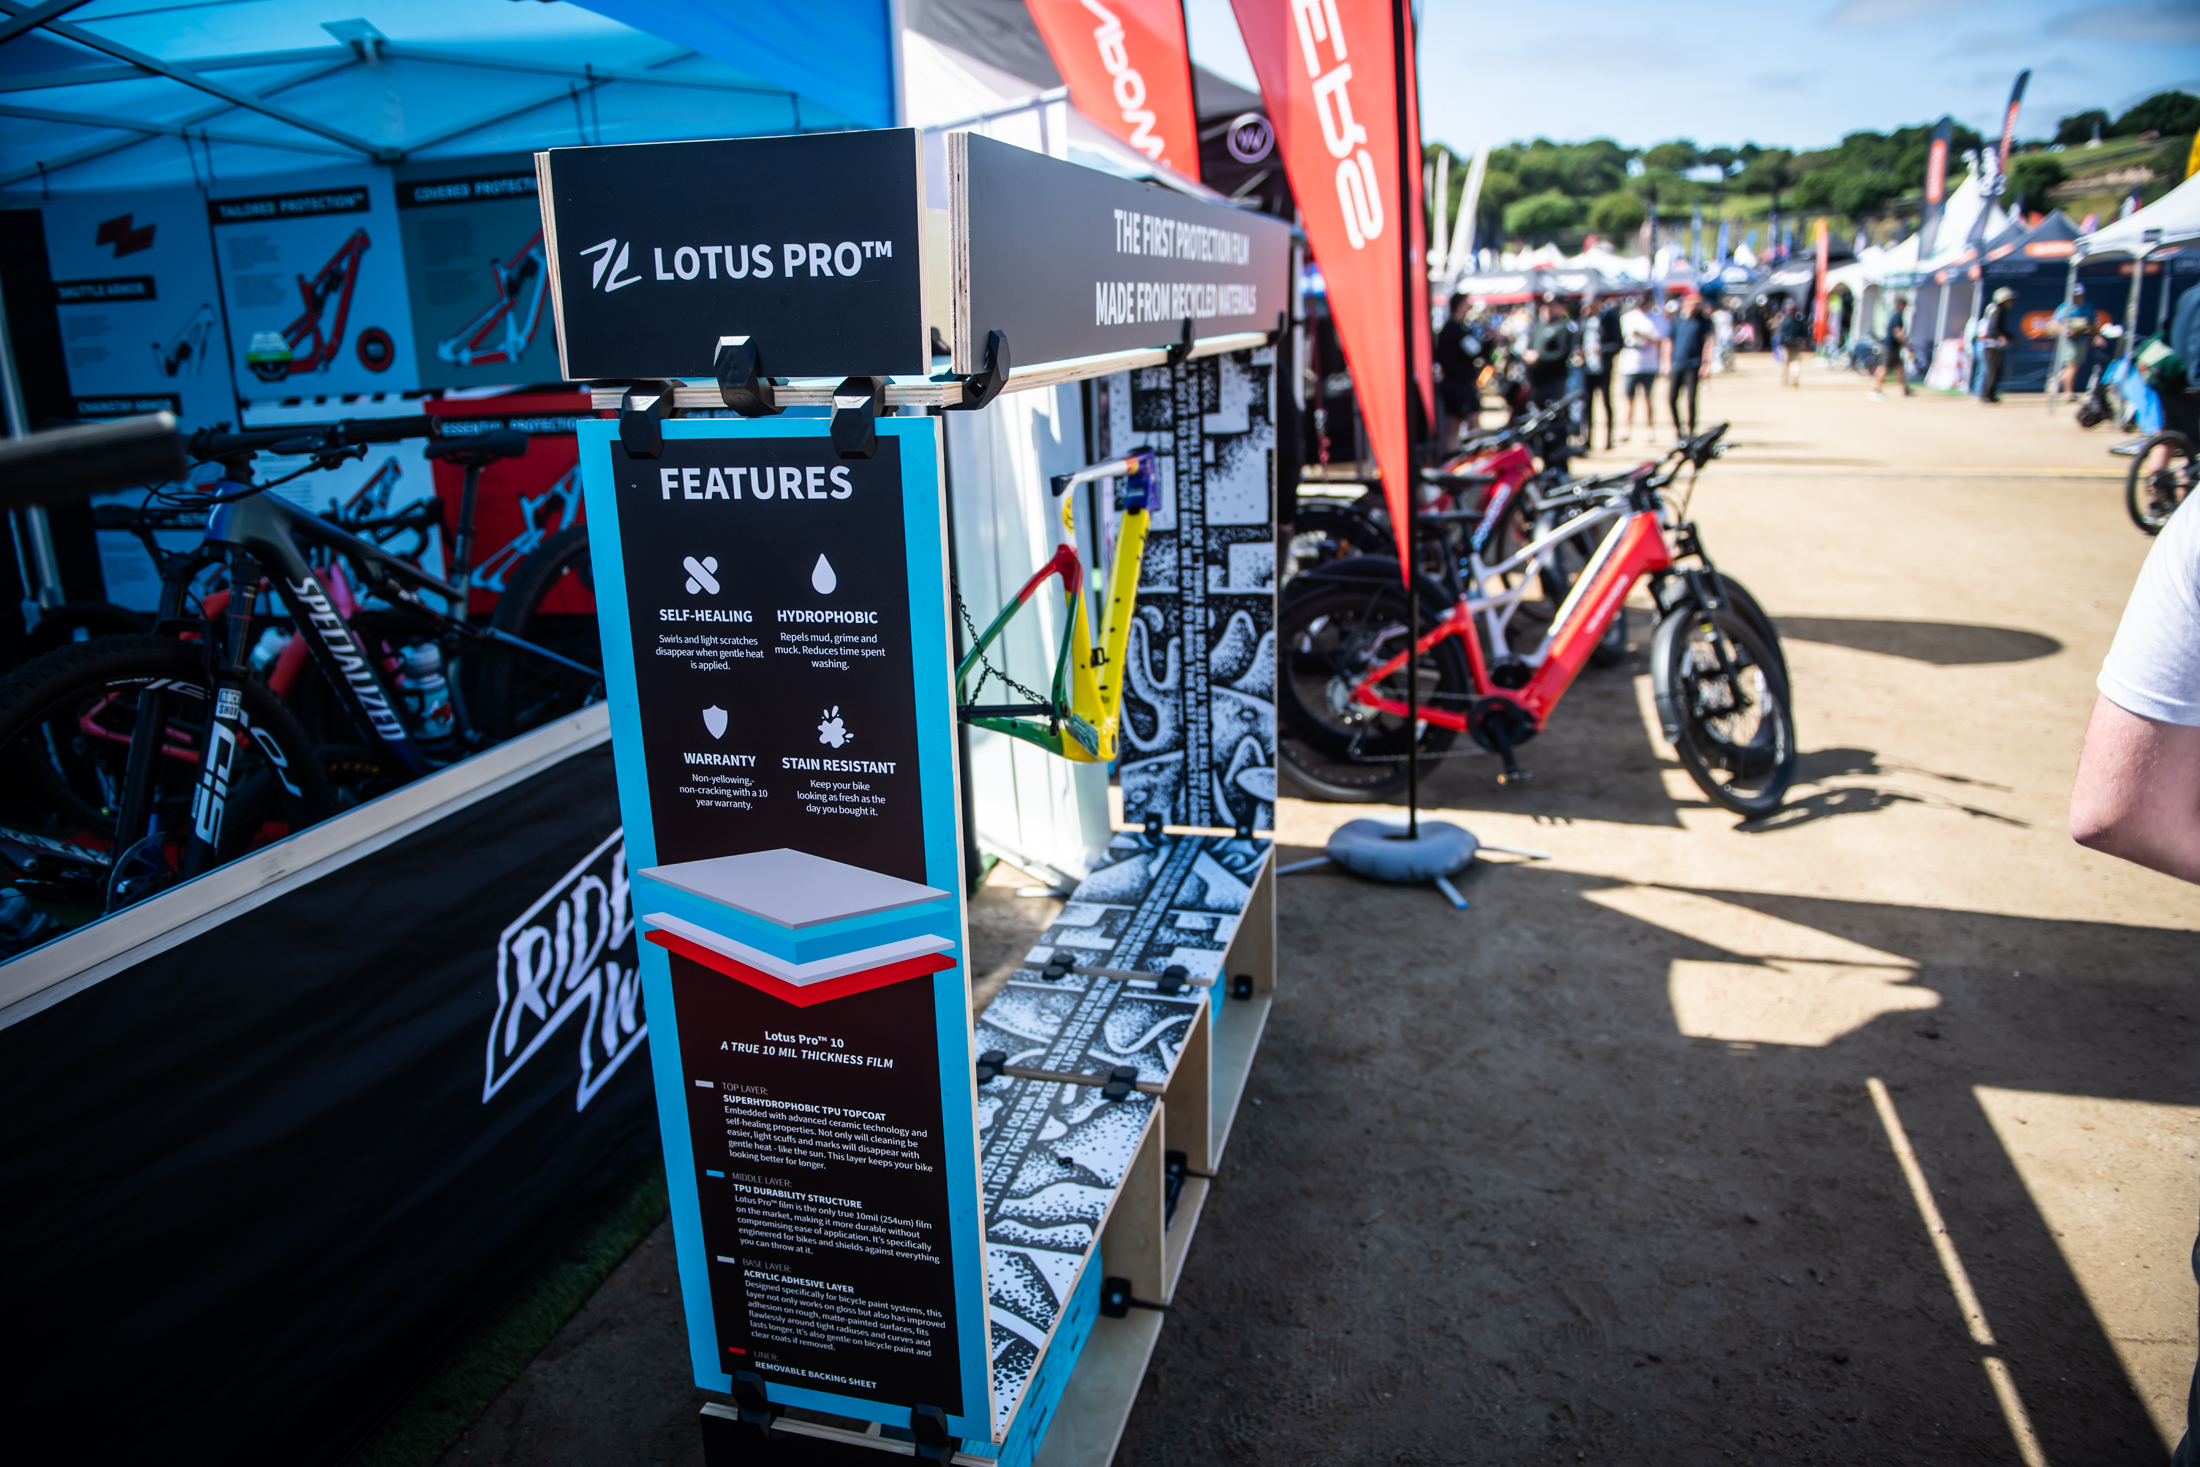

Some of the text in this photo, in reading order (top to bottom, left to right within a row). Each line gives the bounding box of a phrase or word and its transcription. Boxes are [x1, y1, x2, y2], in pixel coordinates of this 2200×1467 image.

[1114, 208, 1250, 266] THE FIRST PROTECTION FILM
[653, 240, 893, 281] LOTUS PRO™
[1096, 281, 1257, 326] MADE FROM RECYCLED MATERIALS
[1175, 382, 1187, 401] DO
[1176, 404, 1188, 416] IT
[1177, 420, 1188, 437] TO
[1177, 439, 1190, 471] SAVE
[659, 465, 853, 500] FEATURES
[1178, 473, 1191, 509] YOUR
[1180, 511, 1192, 545] BIKE.
[1181, 547, 1193, 567] WE
[1182, 569, 1193, 587] DO
[1182, 590, 1194, 602] IT
[659, 608, 752, 622] SELF-HEALING
[777, 609, 878, 624] HYDROPHOBIC
[1183, 605, 1194, 621] TO
[658, 634, 758, 646] Swirls and light scratches
[780, 632, 878, 644] Repels mud, grime and
[1183, 624, 1195, 662] BRING
[286, 577, 407, 741] SPECIALIZED
[655, 646, 764, 659] disappear when gentle heat
[774, 644, 886, 658] muck. Reduces time spent
[690, 659, 730, 671] is applied.
[811, 658, 850, 671] washing.
[1184, 665, 1196, 688] THE
[1185, 690, 1197, 721] BEST
[683, 752, 756, 767] WARRANTY
[1186, 723, 1199, 786] PRODUCTS
[781, 757, 896, 774] STAIN RESISTANT
[679, 786, 732, 798] non-cracking
[732, 787, 750, 796] with
[758, 789, 768, 798] 10
[810, 779, 870, 791] Keep your bike
[695, 799, 753, 810] year warranty.
[796, 790, 828, 803] looking
[838, 792, 860, 802] fresh
[860, 795, 871, 803] as
[871, 794, 886, 804] the
[805, 803, 878, 817] day you bought it.
[764, 1030, 844, 1048] Lotus Pro™ 10
[720, 1040, 893, 1068] A TRUE 10 MIL THICKNESS FILM
[721, 1081, 768, 1095] TOP LAYER:
[723, 1094, 886, 1121] SUPERHYDROPHOBIC TPU TOPCOAT
[724, 1105, 927, 1138] Embedded with advanced ceramic technology and
[1021, 1111, 1045, 1130] THE
[725, 1117, 918, 1148] self-healing properties. Not only will cleaning be
[726, 1129, 920, 1159] easier, light scuffs and marks will disappear with
[1008, 1131, 1033, 1153] FOR
[728, 1140, 933, 1172] gentle heat like the sun. This layer keeps your bike
[1001, 1153, 1019, 1165] IT
[732, 1172, 792, 1188] MIDDLE LAYER:
[991, 1166, 1012, 1183] DO
[733, 1183, 862, 1209] TPU DURABILITY STRUCTURE
[742, 1258, 792, 1273] BASE LAYER:
[743, 1269, 854, 1293] ACRYLIC ADHESIVE LAYER
[755, 1360, 877, 1389] REMOVABLE BACKING SHEET
